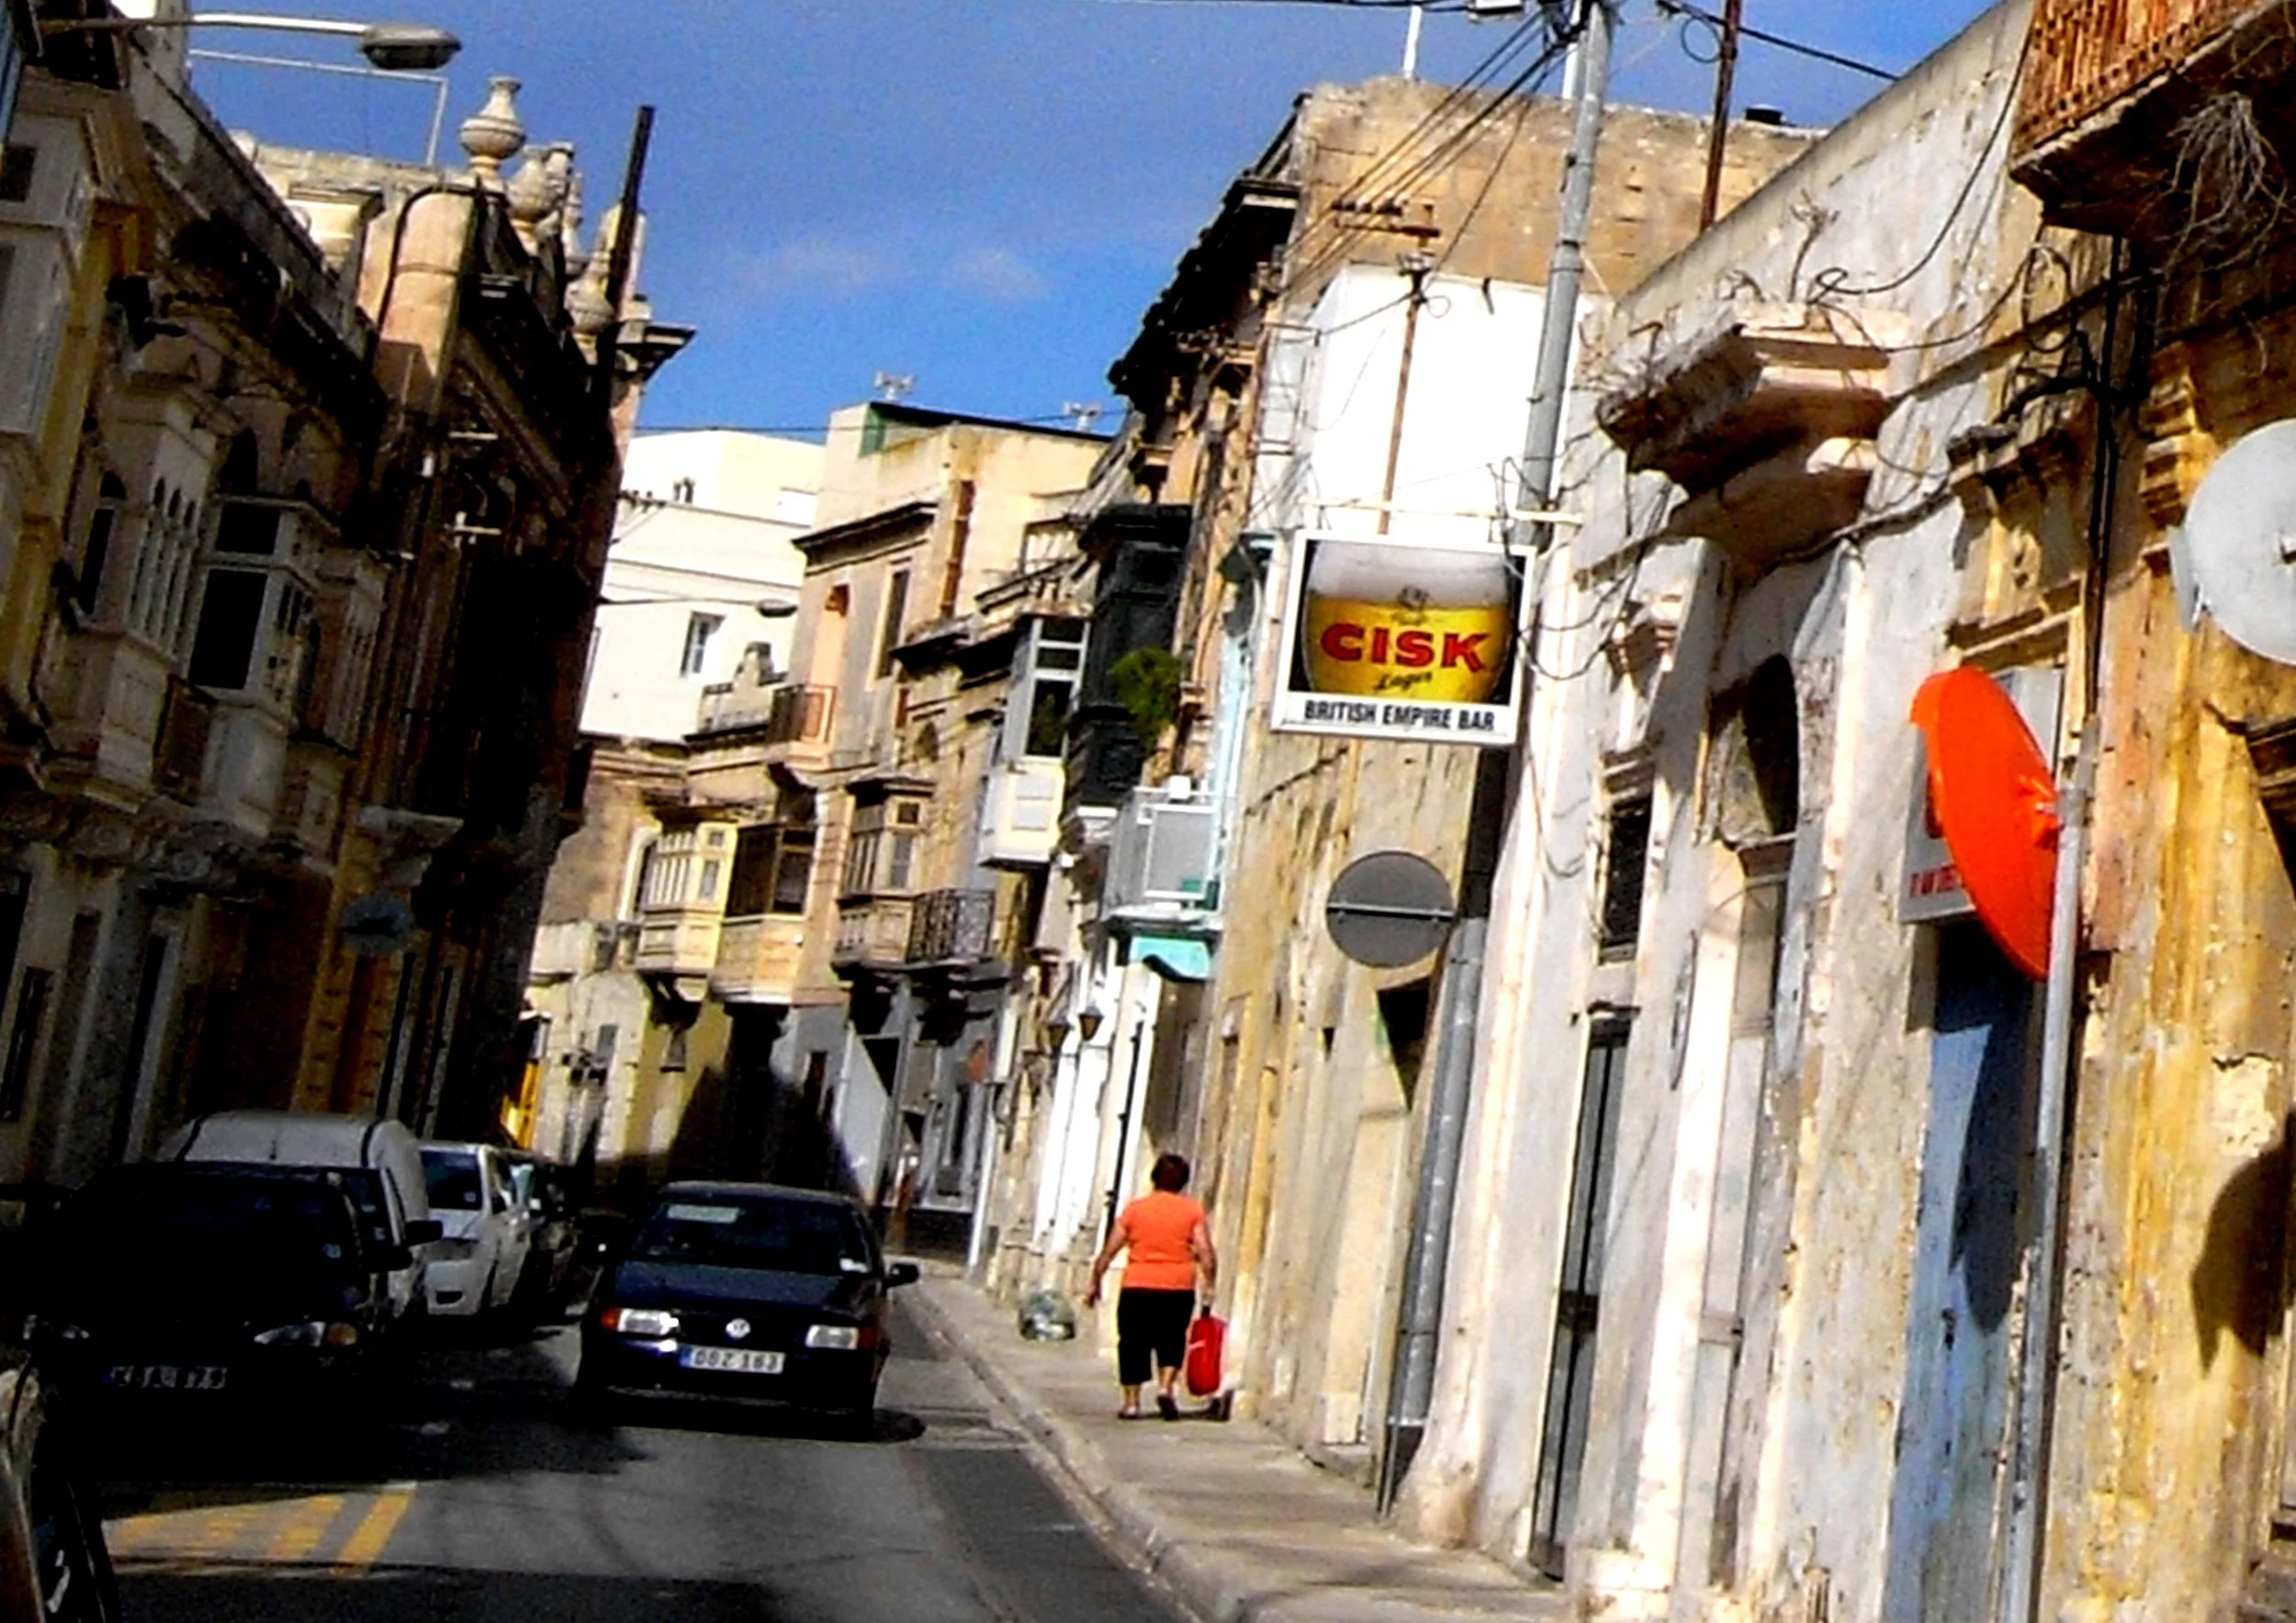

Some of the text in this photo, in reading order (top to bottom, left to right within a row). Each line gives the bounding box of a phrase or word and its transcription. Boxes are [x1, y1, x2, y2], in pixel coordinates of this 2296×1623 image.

[1321, 623, 1490, 672] CISK
[1304, 699, 1495, 731] BRITISH EMPIRE BAR
